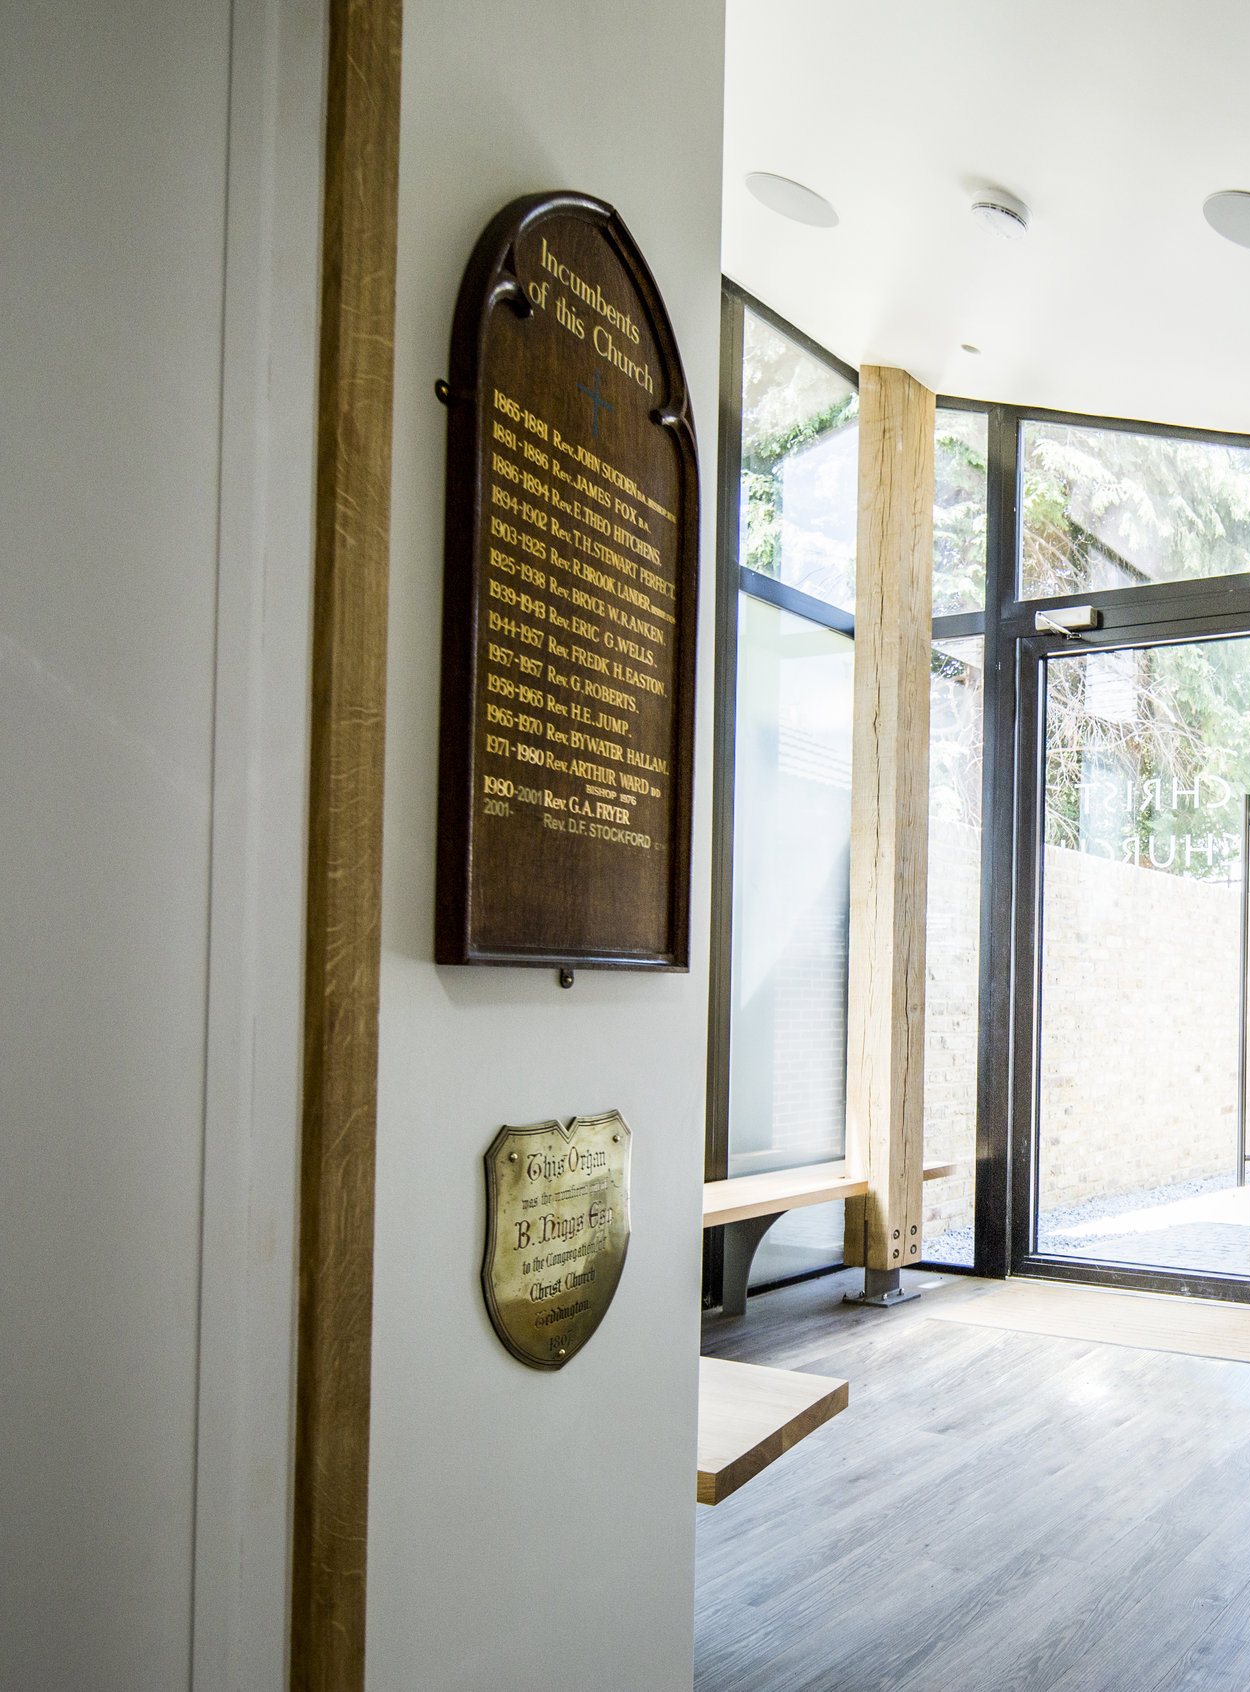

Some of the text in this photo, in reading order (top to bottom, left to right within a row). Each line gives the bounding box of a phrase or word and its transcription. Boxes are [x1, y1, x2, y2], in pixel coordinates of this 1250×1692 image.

[541, 237, 640, 344] Incumbents
[528, 281, 654, 395] of this Church
[492, 420, 548, 469] 1881-1886
[552, 458, 574, 485] Rev.
[573, 474, 611, 507] JAMES
[614, 497, 637, 524] FOX
[493, 388, 548, 440] 1865-1881
[552, 428, 574, 458] Rev.
[573, 445, 600, 473] JOHN
[601, 462, 637, 497] SUGDEN
[492, 452, 549, 501] 1886-1894
[551, 487, 572, 515] Rev.
[491, 484, 547, 530] 1894-1902
[550, 516, 572, 544] Rev.
[491, 516, 546, 559] 1903-1925
[550, 547, 571, 572] Rev.
[489, 547, 545, 588] 1925-1938
[549, 576, 570, 600] Rev.
[572, 587, 605, 616] BRYCE
[489, 578, 545, 618] 1939-1943
[548, 605, 570, 630] Rev.
[571, 616, 599, 642] ERIC
[488, 610, 544, 648] 1944-1957
[548, 635, 569, 659] Rev.
[571, 645, 609, 675] FREDK
[488, 642, 543, 677] 1957-1957
[547, 664, 568, 687] Rev.
[487, 673, 543, 707] 1958-1965
[546, 693, 568, 716] Rev.
[486, 703, 542, 735] 1965-1970
[546, 722, 568, 745] Rev.
[570, 730, 624, 761] BYWATER
[483, 775, 541, 804] 1980-2001
[543, 789, 566, 810] Rev.
[486, 733, 544, 765] 1971-1980
[545, 750, 568, 772] Rev.
[568, 758, 616, 786] ARTHUR
[619, 771, 649, 794] WARD
[585, 784, 617, 799] BISHOP
[543, 812, 566, 832] Rev.
[589, 822, 651, 849] STOCKFORD
[527, 1146, 606, 1183] This Organ
[513, 1220, 535, 1251] B.
[530, 1266, 596, 1303] Christ Church
